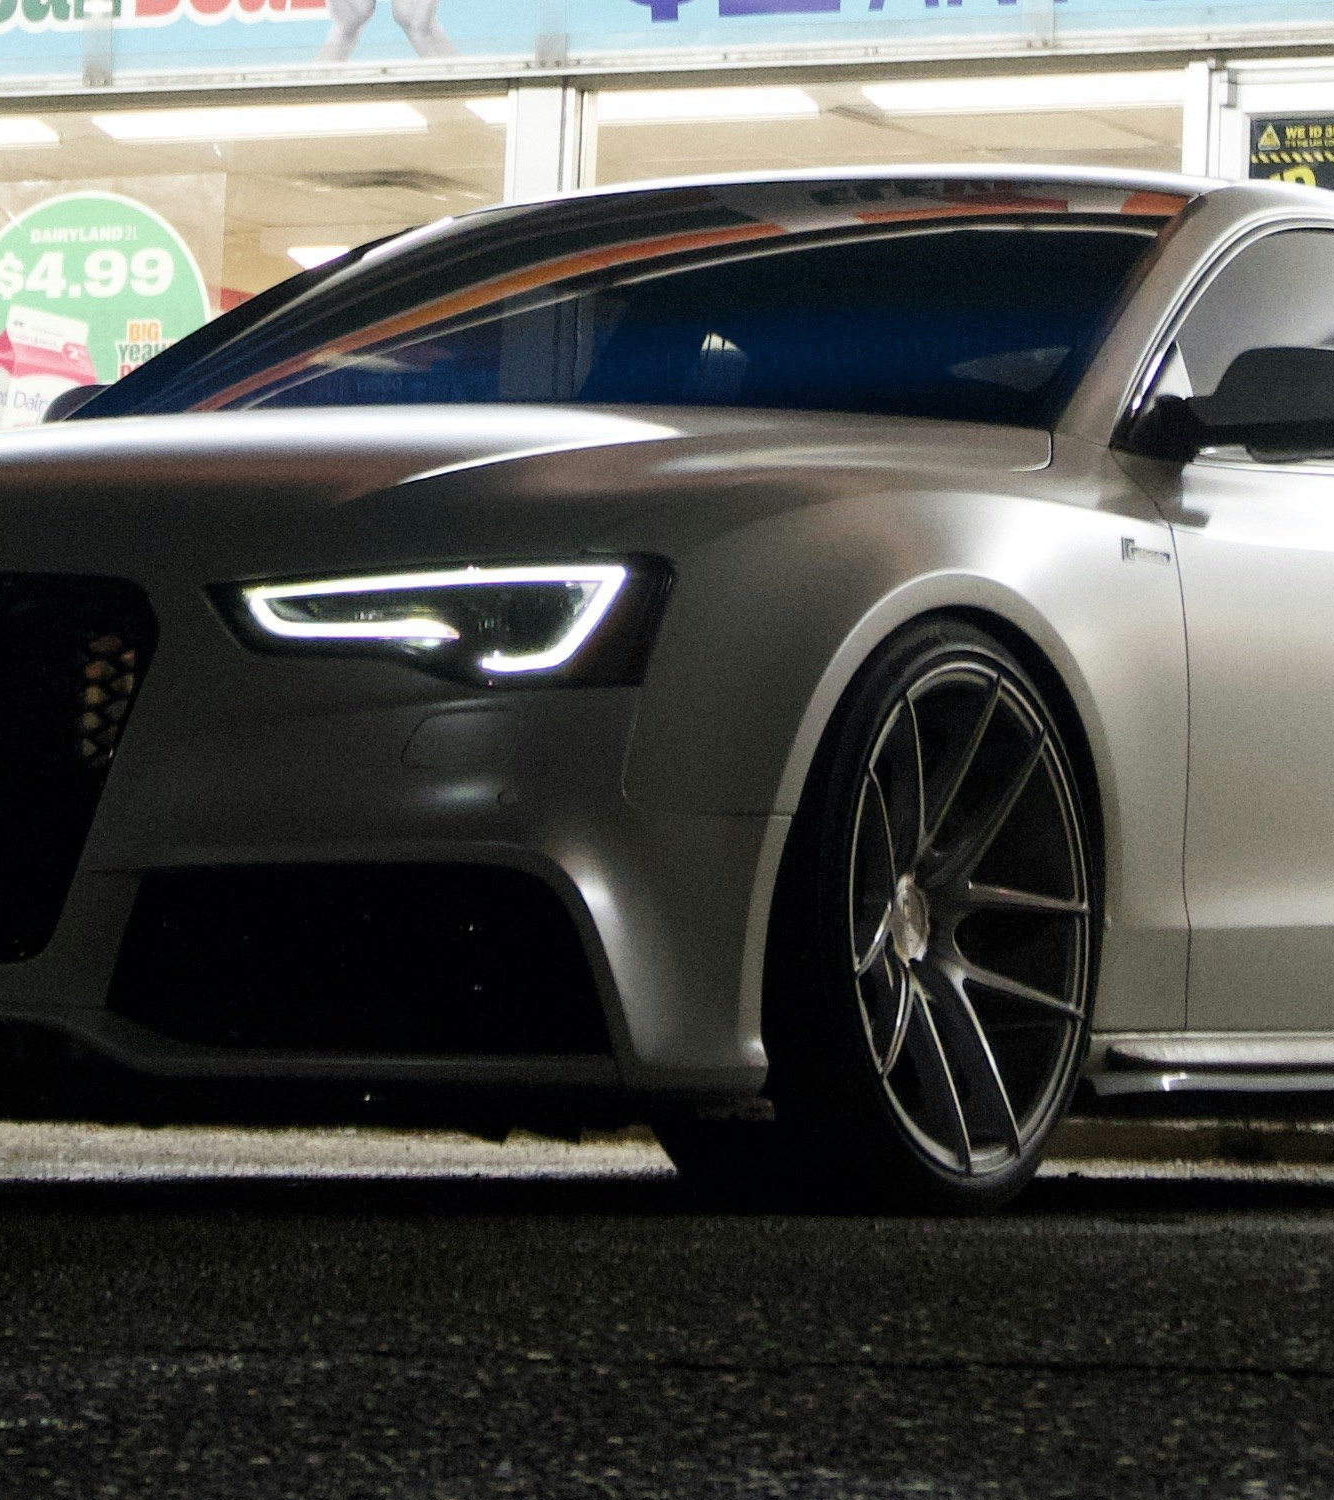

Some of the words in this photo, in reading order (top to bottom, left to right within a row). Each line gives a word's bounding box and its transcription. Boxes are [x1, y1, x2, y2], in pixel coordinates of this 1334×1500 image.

[1285, 126, 1306, 140] WE
[1309, 125, 1323, 139] ID
[30, 226, 123, 243] DAIRYLAND
